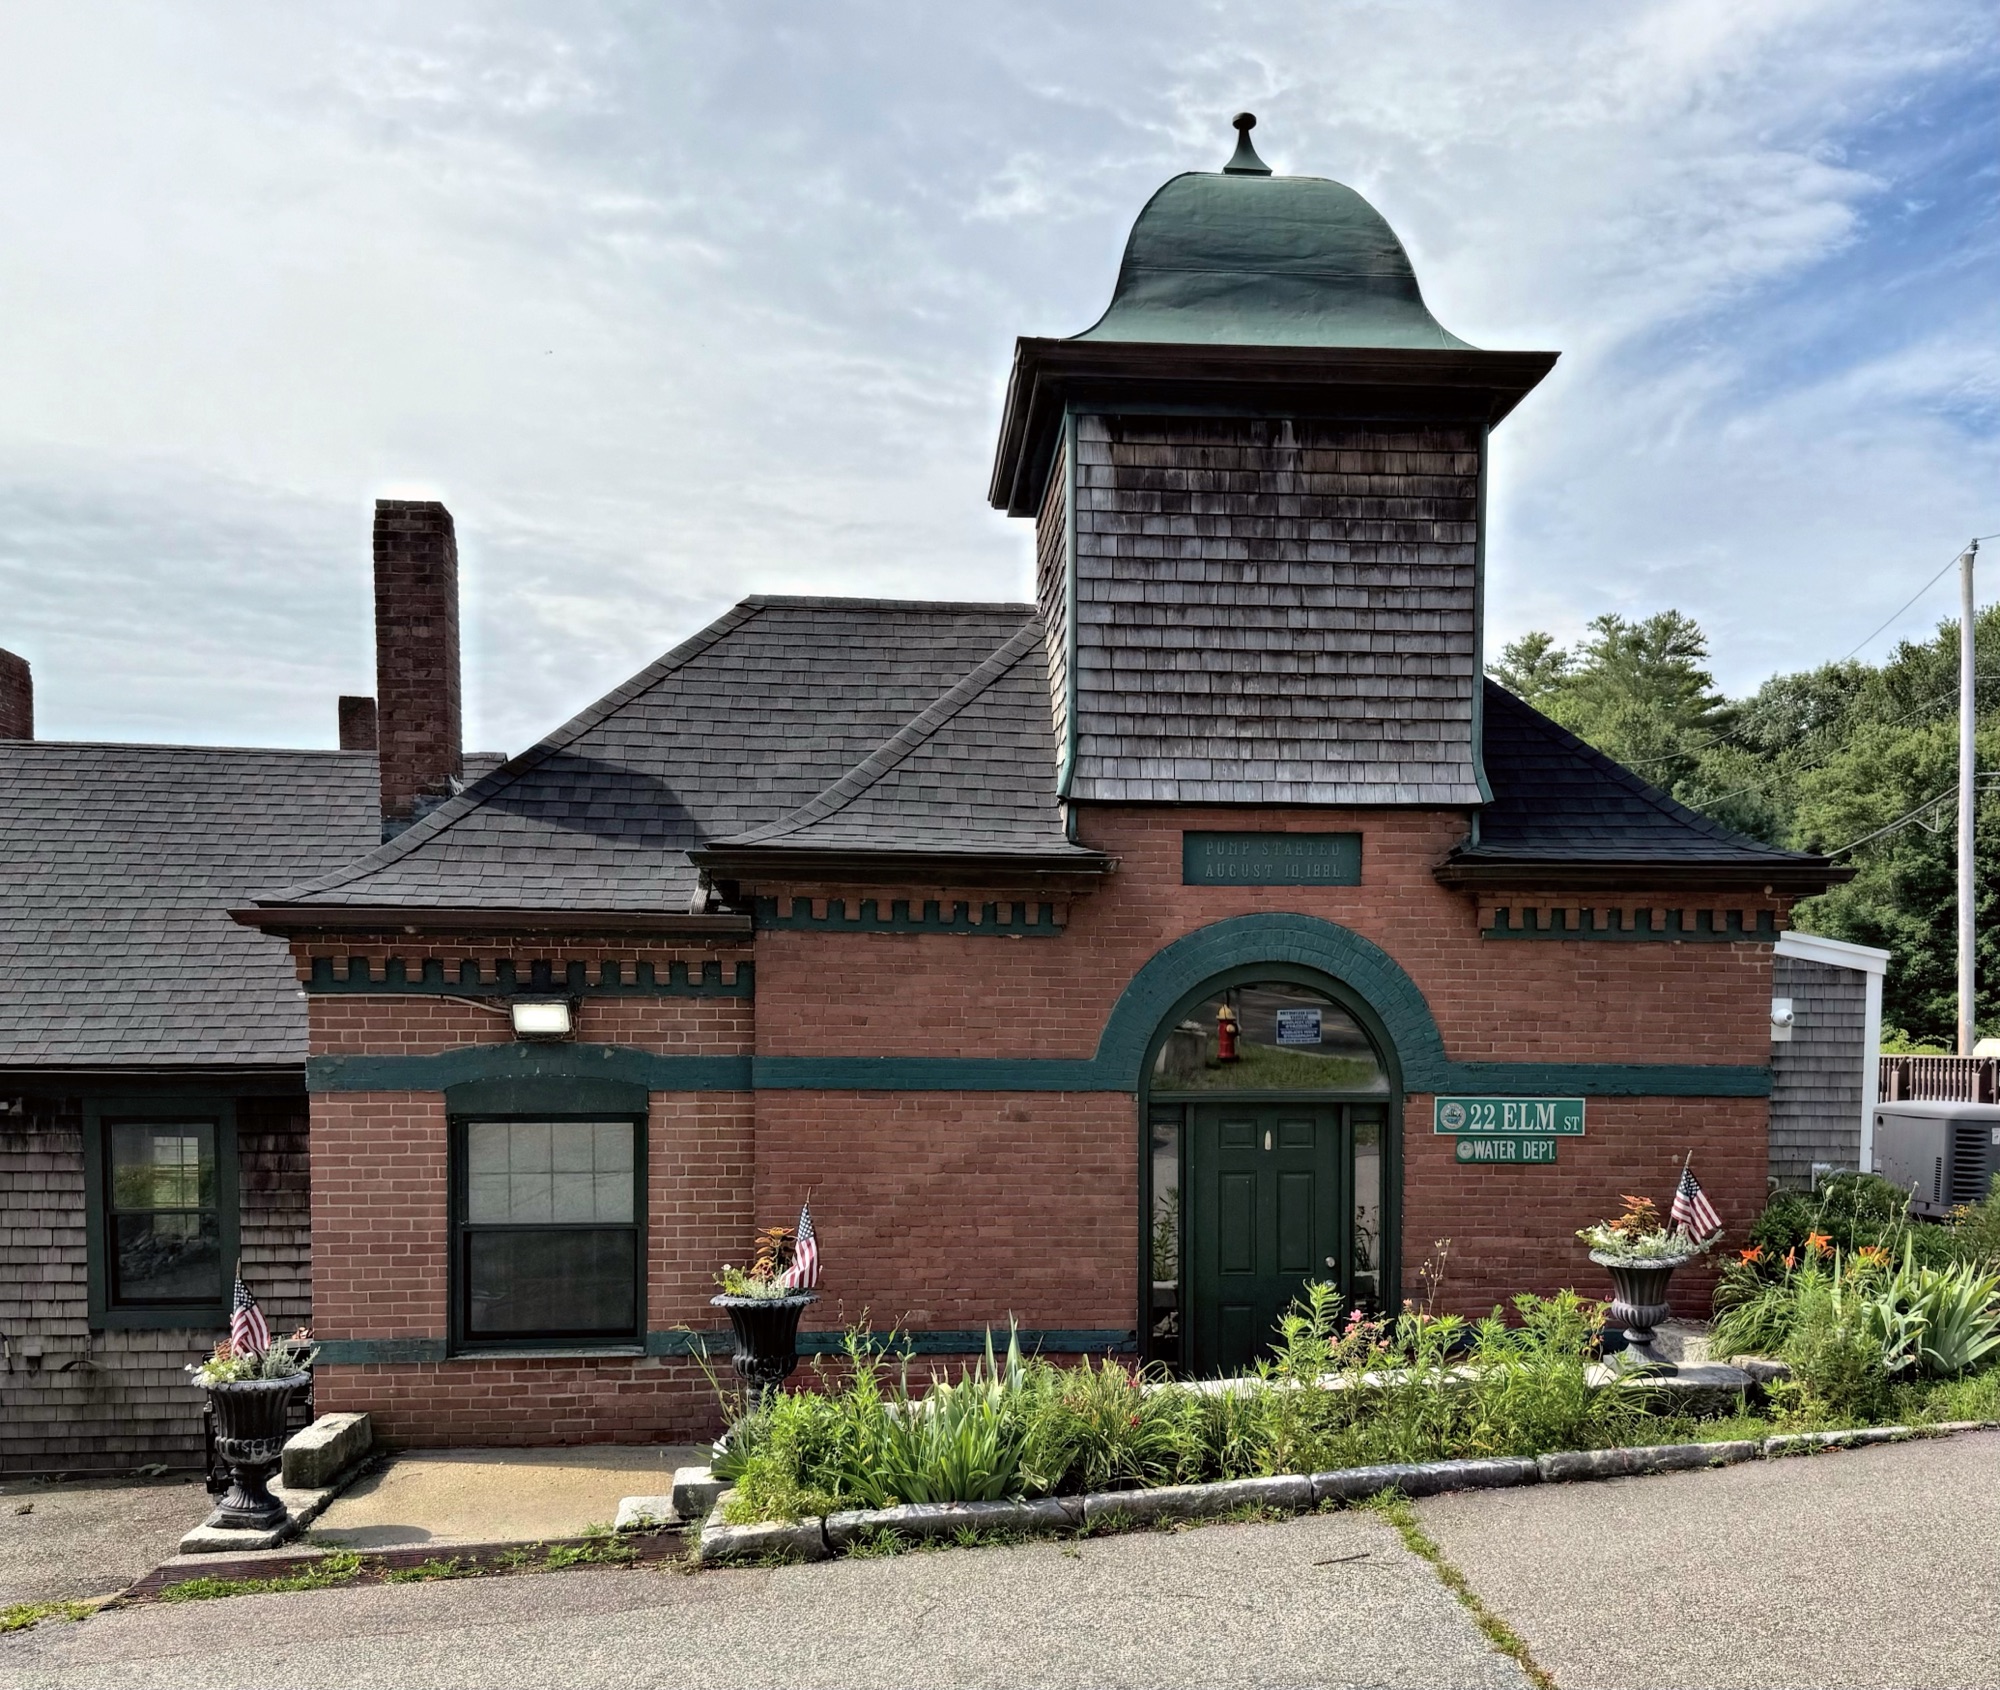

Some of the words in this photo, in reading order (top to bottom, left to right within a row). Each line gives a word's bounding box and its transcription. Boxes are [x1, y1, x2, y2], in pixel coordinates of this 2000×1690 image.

[1206, 841, 1250, 856] PUMP
[1262, 841, 1340, 856] STARTED
[1205, 863, 1273, 878] AUGUST
[1469, 1103, 1496, 1130] 22
[1501, 1103, 1557, 1130] ELM
[1563, 1116, 1580, 1131] ST
[1474, 1140, 1516, 1159] WATER
[1523, 1141, 1556, 1159] DEPT.
